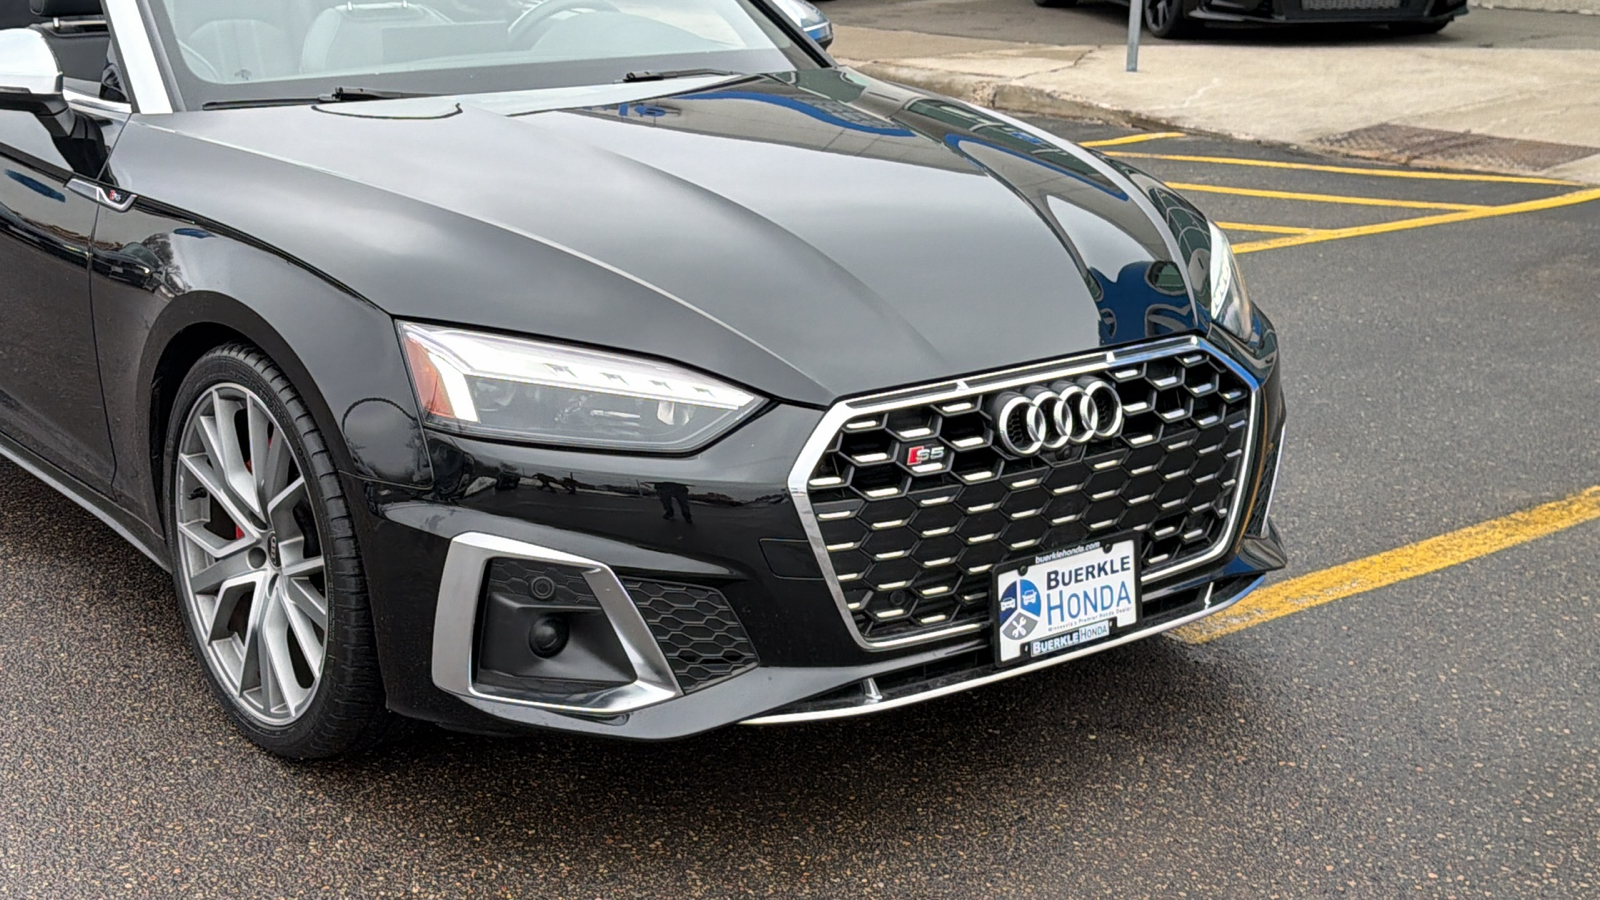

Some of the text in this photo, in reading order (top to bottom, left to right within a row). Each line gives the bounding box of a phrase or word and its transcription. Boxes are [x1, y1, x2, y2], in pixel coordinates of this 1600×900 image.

[914, 446, 945, 462] S5
[1035, 541, 1101, 564] buerklehonda.com
[1046, 555, 1131, 591] BUERKLE
[1046, 580, 1132, 626] HONDA
[1032, 624, 1108, 655] BUERKLE HONDA
